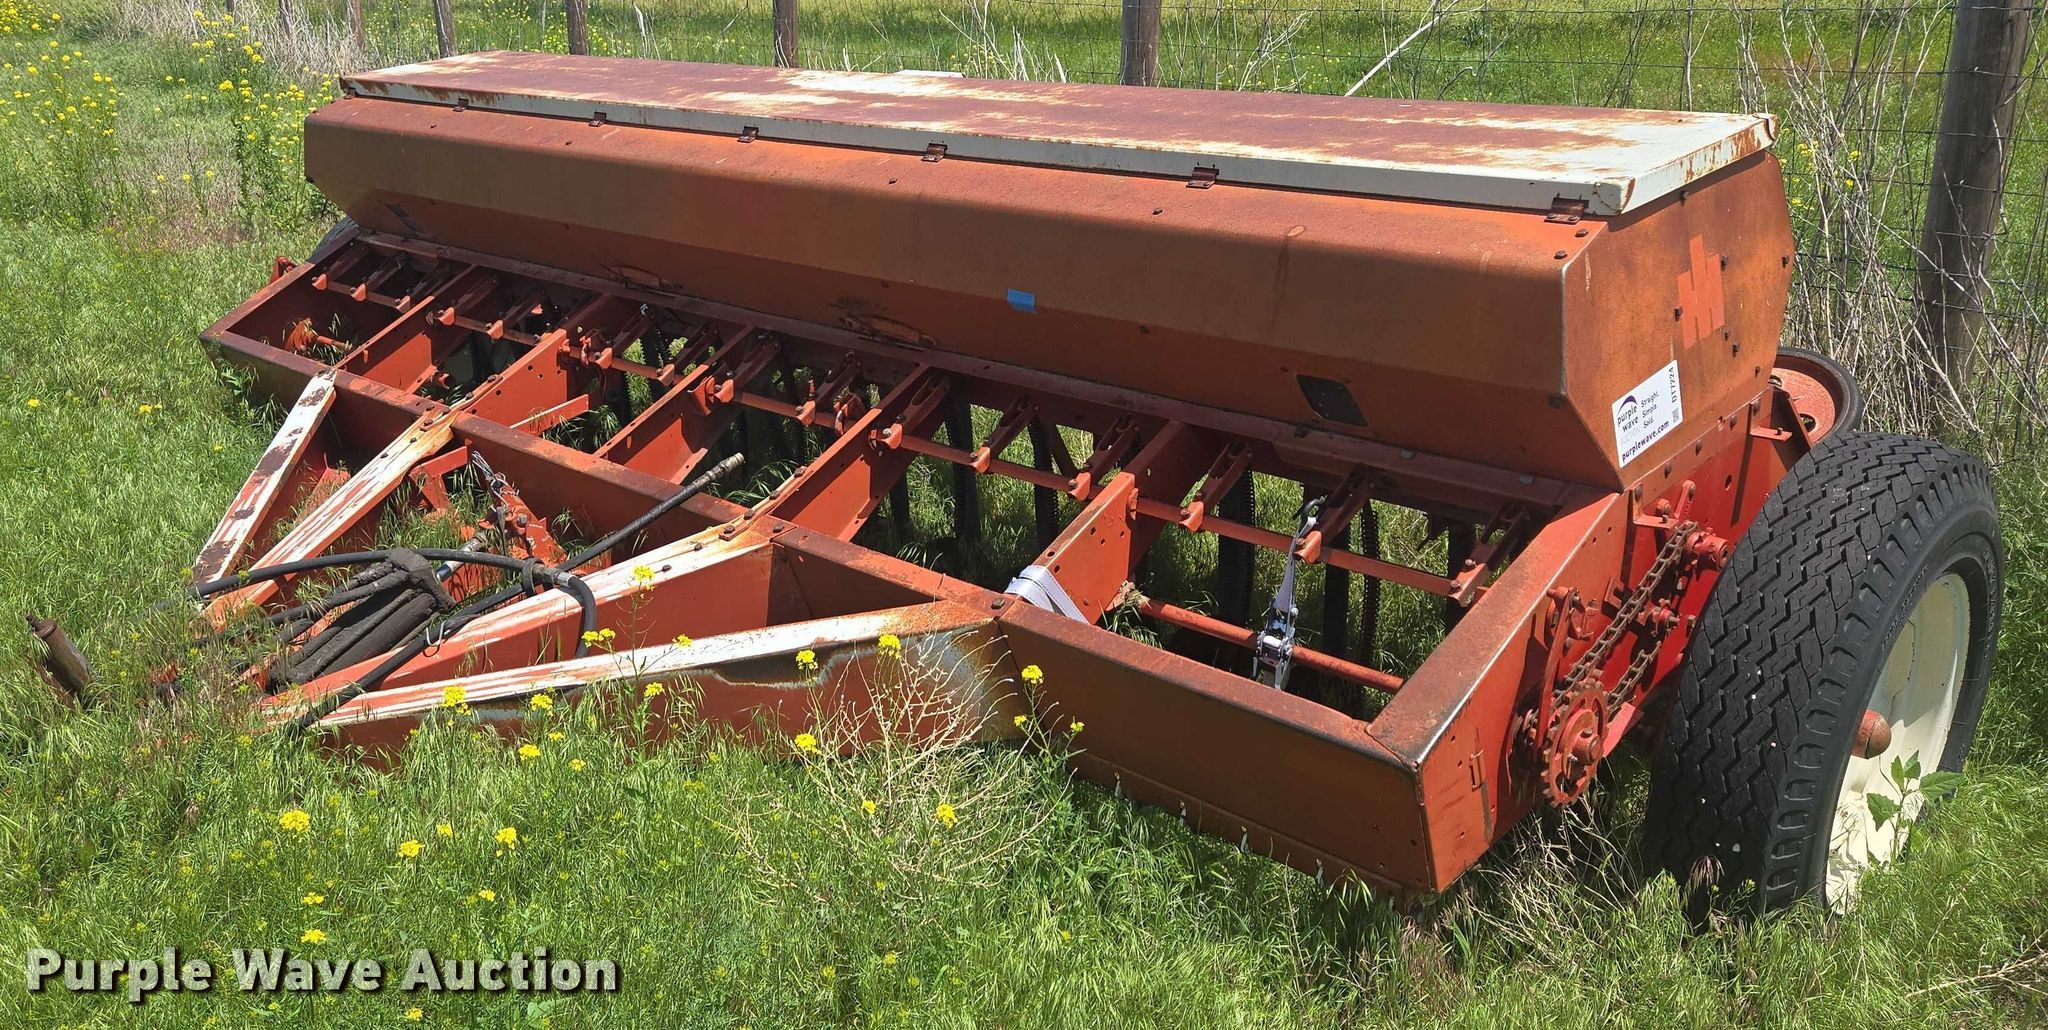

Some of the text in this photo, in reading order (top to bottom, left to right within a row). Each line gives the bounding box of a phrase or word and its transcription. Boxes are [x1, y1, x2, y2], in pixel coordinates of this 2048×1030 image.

[1617, 405, 1638, 427] purple
[1622, 416, 1639, 432] wave
[1621, 420, 1670, 463] purplewave.com
